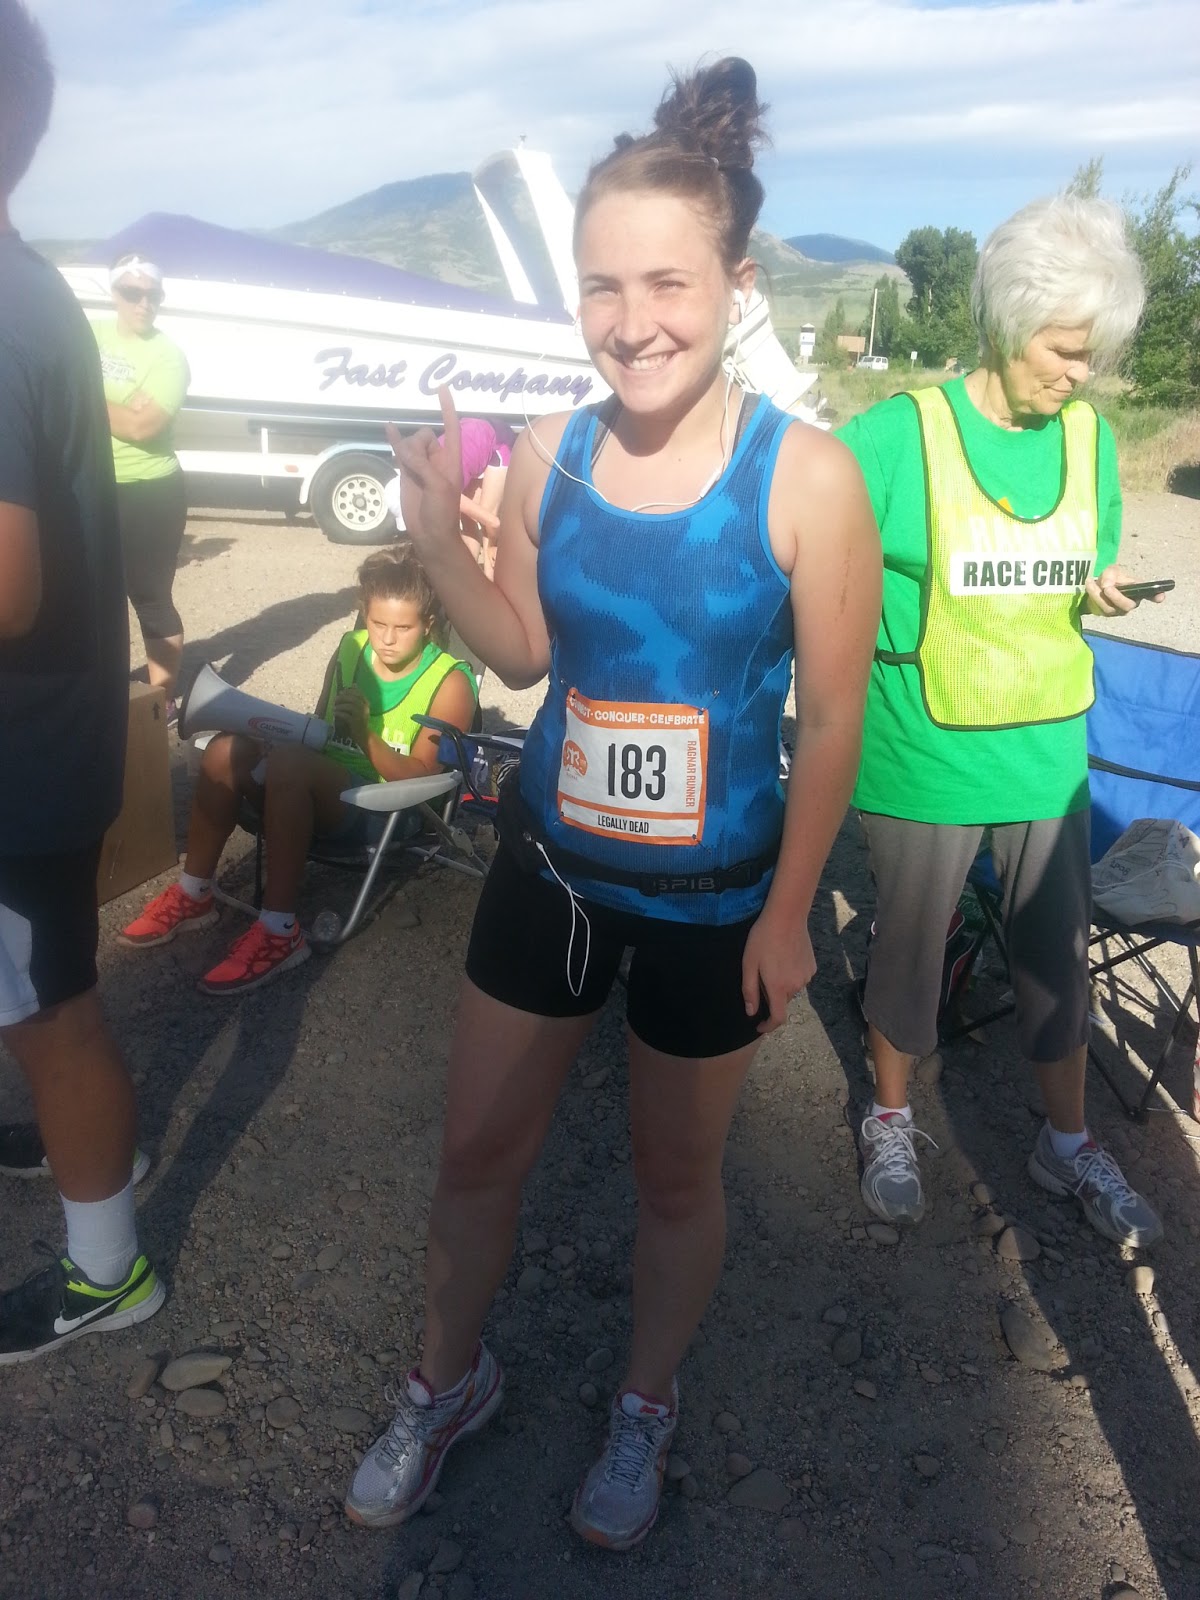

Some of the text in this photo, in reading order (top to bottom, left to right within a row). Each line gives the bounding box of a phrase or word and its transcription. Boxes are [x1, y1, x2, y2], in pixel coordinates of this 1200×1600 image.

[314, 347, 593, 406] Fast Company
[963, 560, 1091, 587] RACE CREW
[594, 711, 645, 724] CONQUER
[650, 713, 705, 726] CELEBRATE
[608, 743, 667, 801] 183
[685, 740, 697, 808] RAGNAR RUNNER
[597, 814, 650, 834] LEGALLY DEAD
